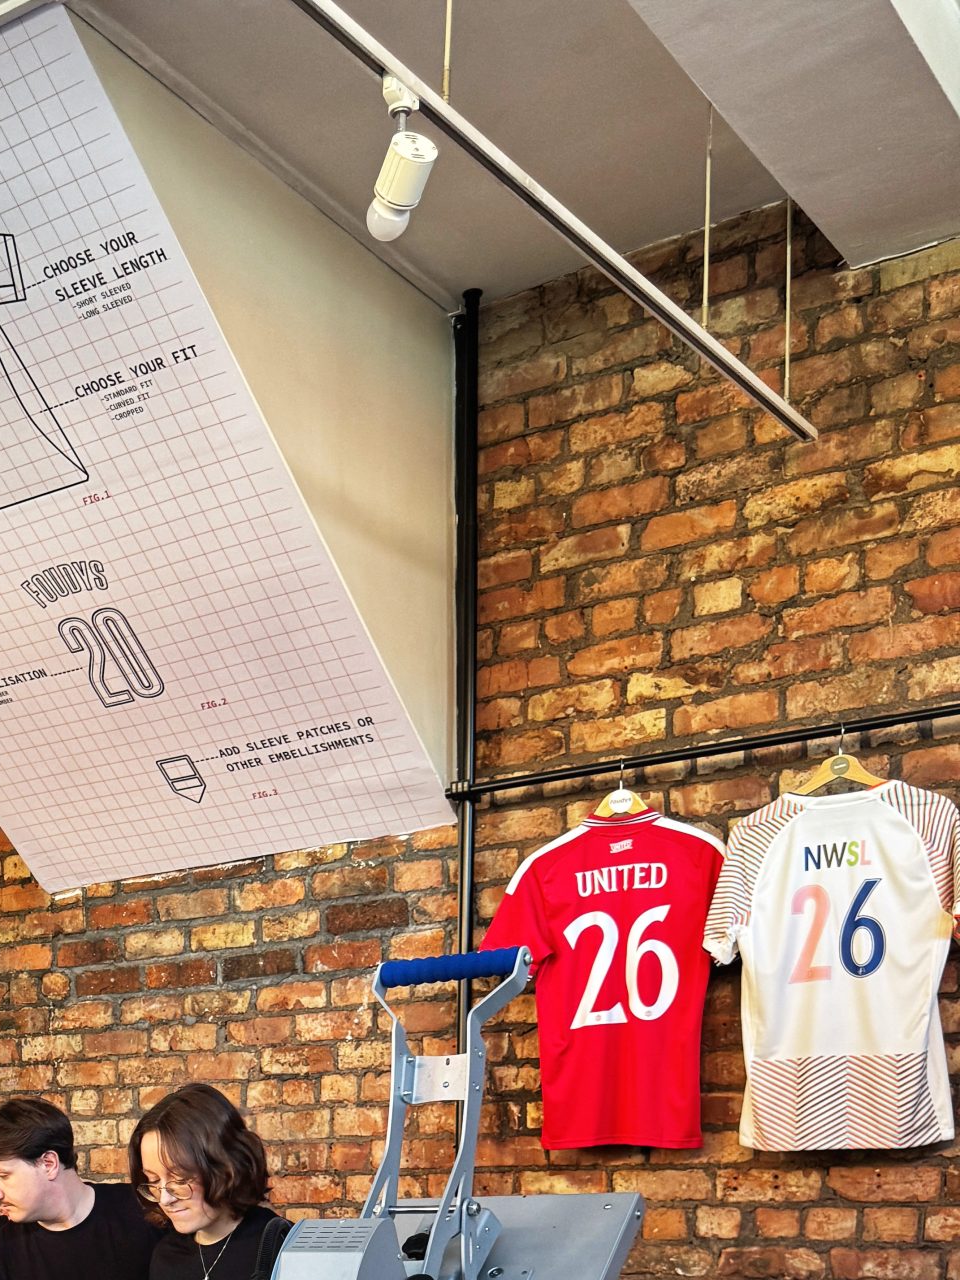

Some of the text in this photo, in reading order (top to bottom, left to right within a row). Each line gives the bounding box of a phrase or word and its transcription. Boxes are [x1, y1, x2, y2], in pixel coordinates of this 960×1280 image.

[43, 231, 139, 279] CHOOSE YOUR
[55, 248, 167, 302] SLEEVE LENGTH
[100, 282, 131, 299] SLEEVED
[102, 295, 133, 312] SLEEVED
[75, 345, 198, 398] CHOOSE YOUR FIT
[140, 379, 154, 390] FIT
[137, 392, 151, 402] FIT
[82, 490, 111, 506] FIG.1
[21, 560, 108, 609] FOUDYS
[58, 607, 164, 708] 20
[200, 698, 228, 710] FIG.2
[219, 716, 375, 758] ADD SLEEVE PATCHES OR
[226, 733, 375, 772] OTHER EMBELLISHMENTS
[252, 789, 278, 800] FIG.3
[804, 840, 872, 871] NWSL
[575, 862, 668, 898] UNITED
[788, 878, 886, 984] 26
[563, 904, 680, 1030] 26
